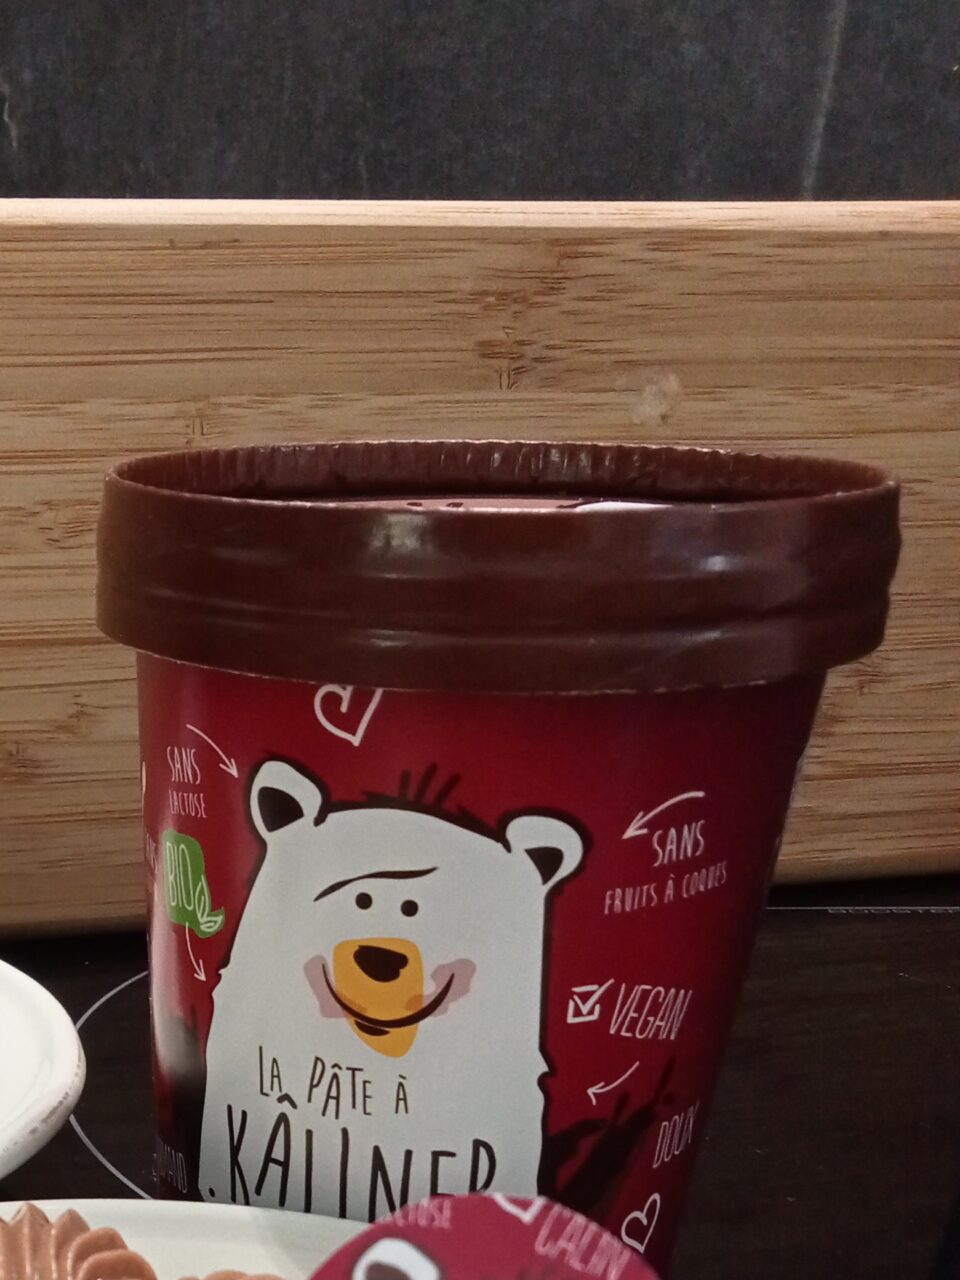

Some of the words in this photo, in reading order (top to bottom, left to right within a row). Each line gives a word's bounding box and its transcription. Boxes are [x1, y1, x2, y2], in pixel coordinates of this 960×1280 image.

[166, 746, 201, 785] SANS
[168, 789, 207, 818] LACTOSE
[652, 819, 706, 868] SANS
[165, 841, 194, 912] BIO
[603, 883, 658, 915] FRUITS
[663, 873, 676, 904] À
[682, 860, 728, 899] COQUES
[609, 983, 693, 1041] VEGAN
[258, 1045, 282, 1097] LA
[307, 1056, 374, 1120] PÂTE
[394, 1074, 409, 1115] À
